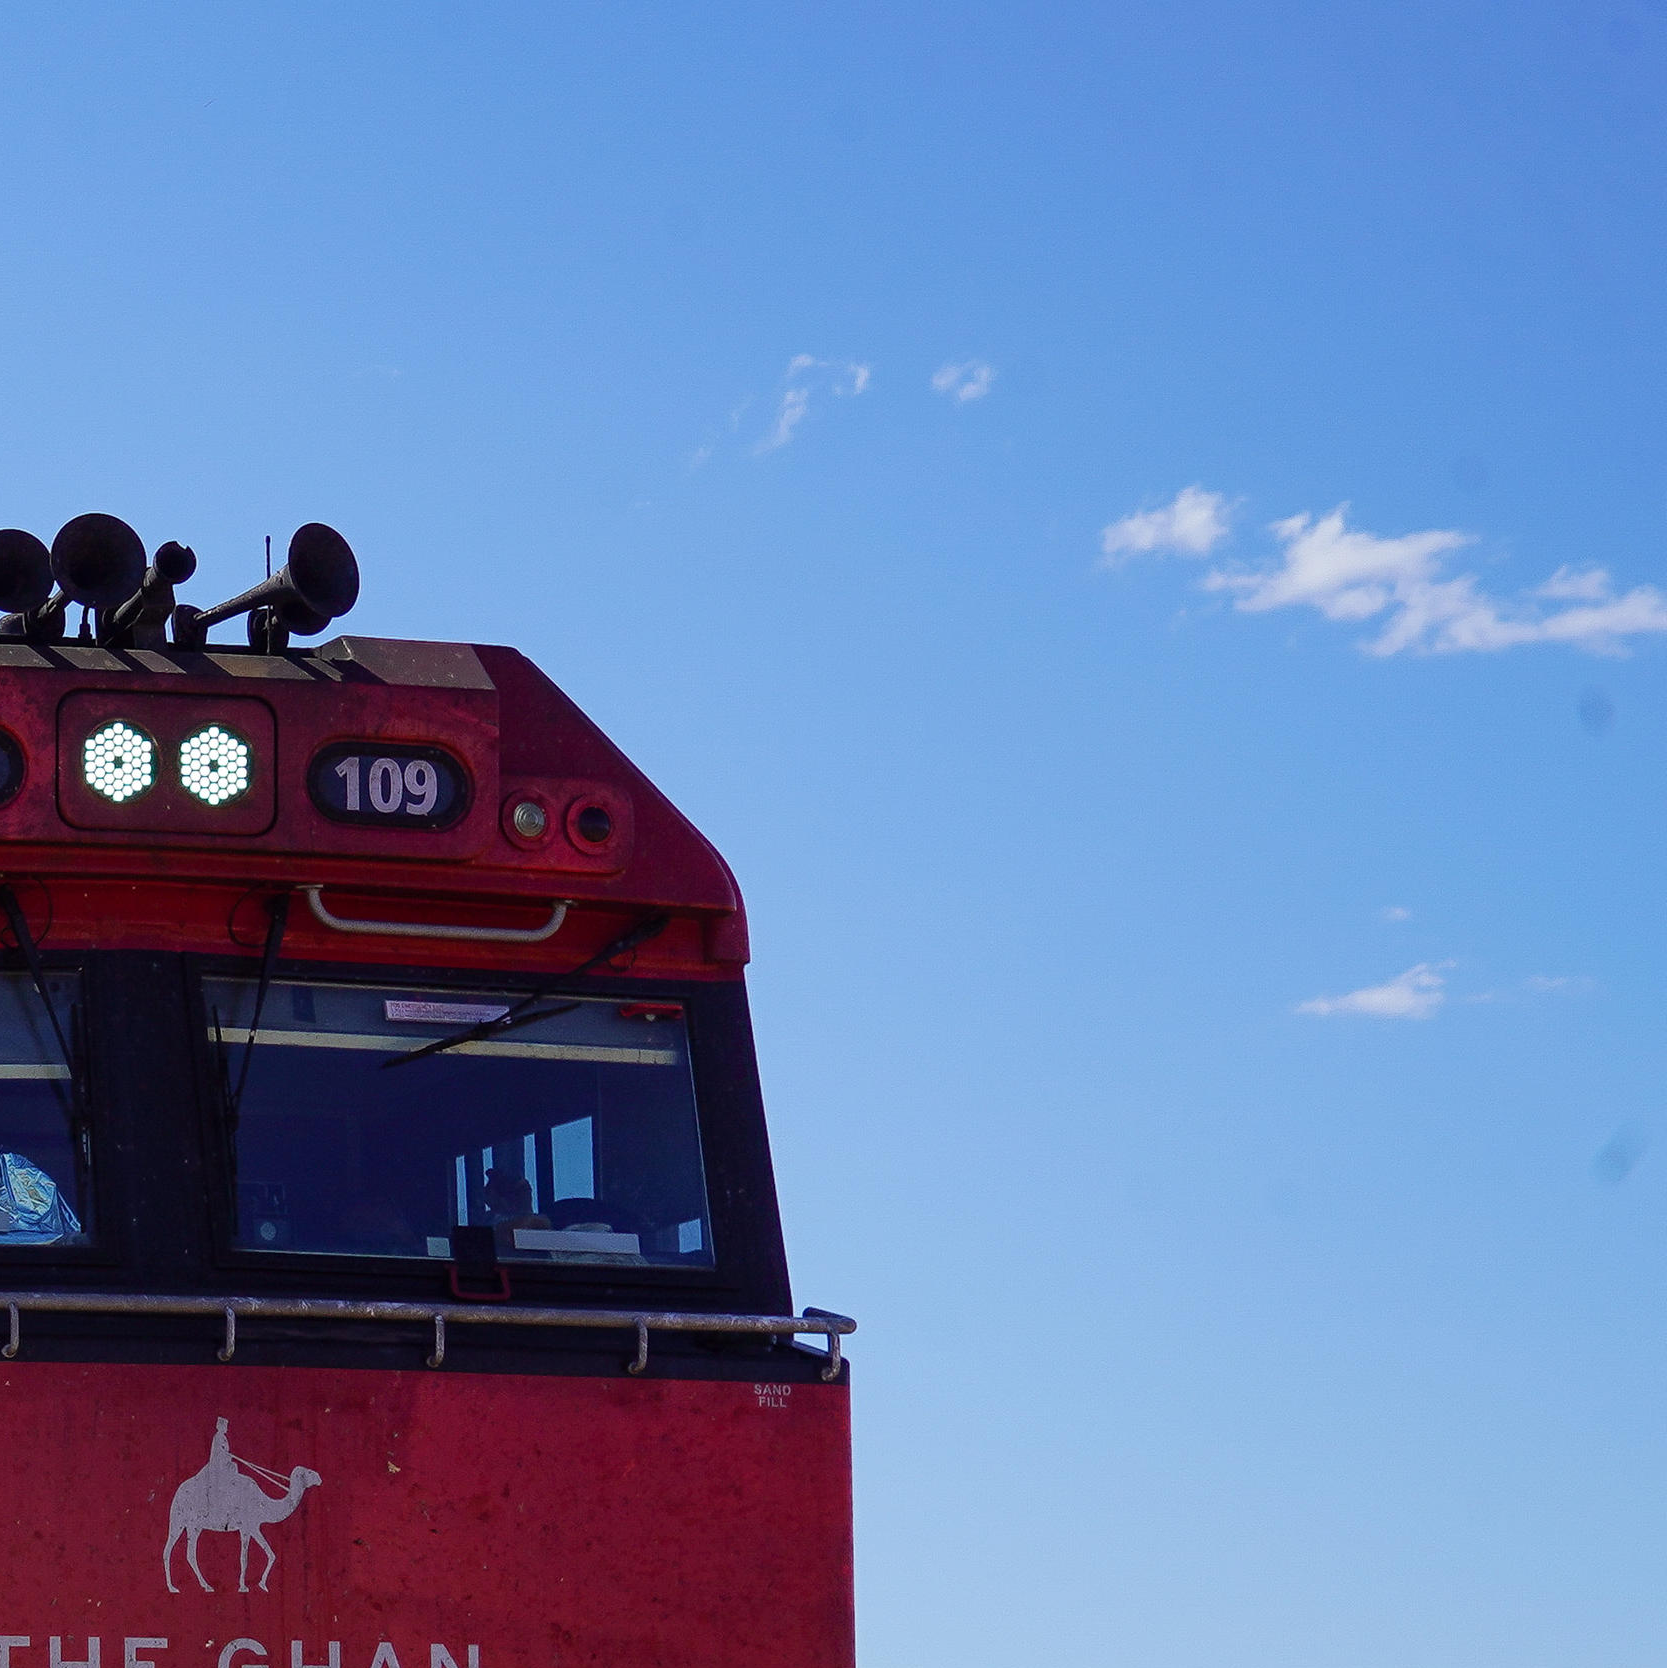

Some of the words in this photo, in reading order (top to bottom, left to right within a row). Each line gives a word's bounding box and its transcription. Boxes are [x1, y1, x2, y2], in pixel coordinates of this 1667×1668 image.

[334, 757, 438, 816] 109
[754, 1383, 792, 1396] SAND
[758, 1396, 787, 1408] FILL
